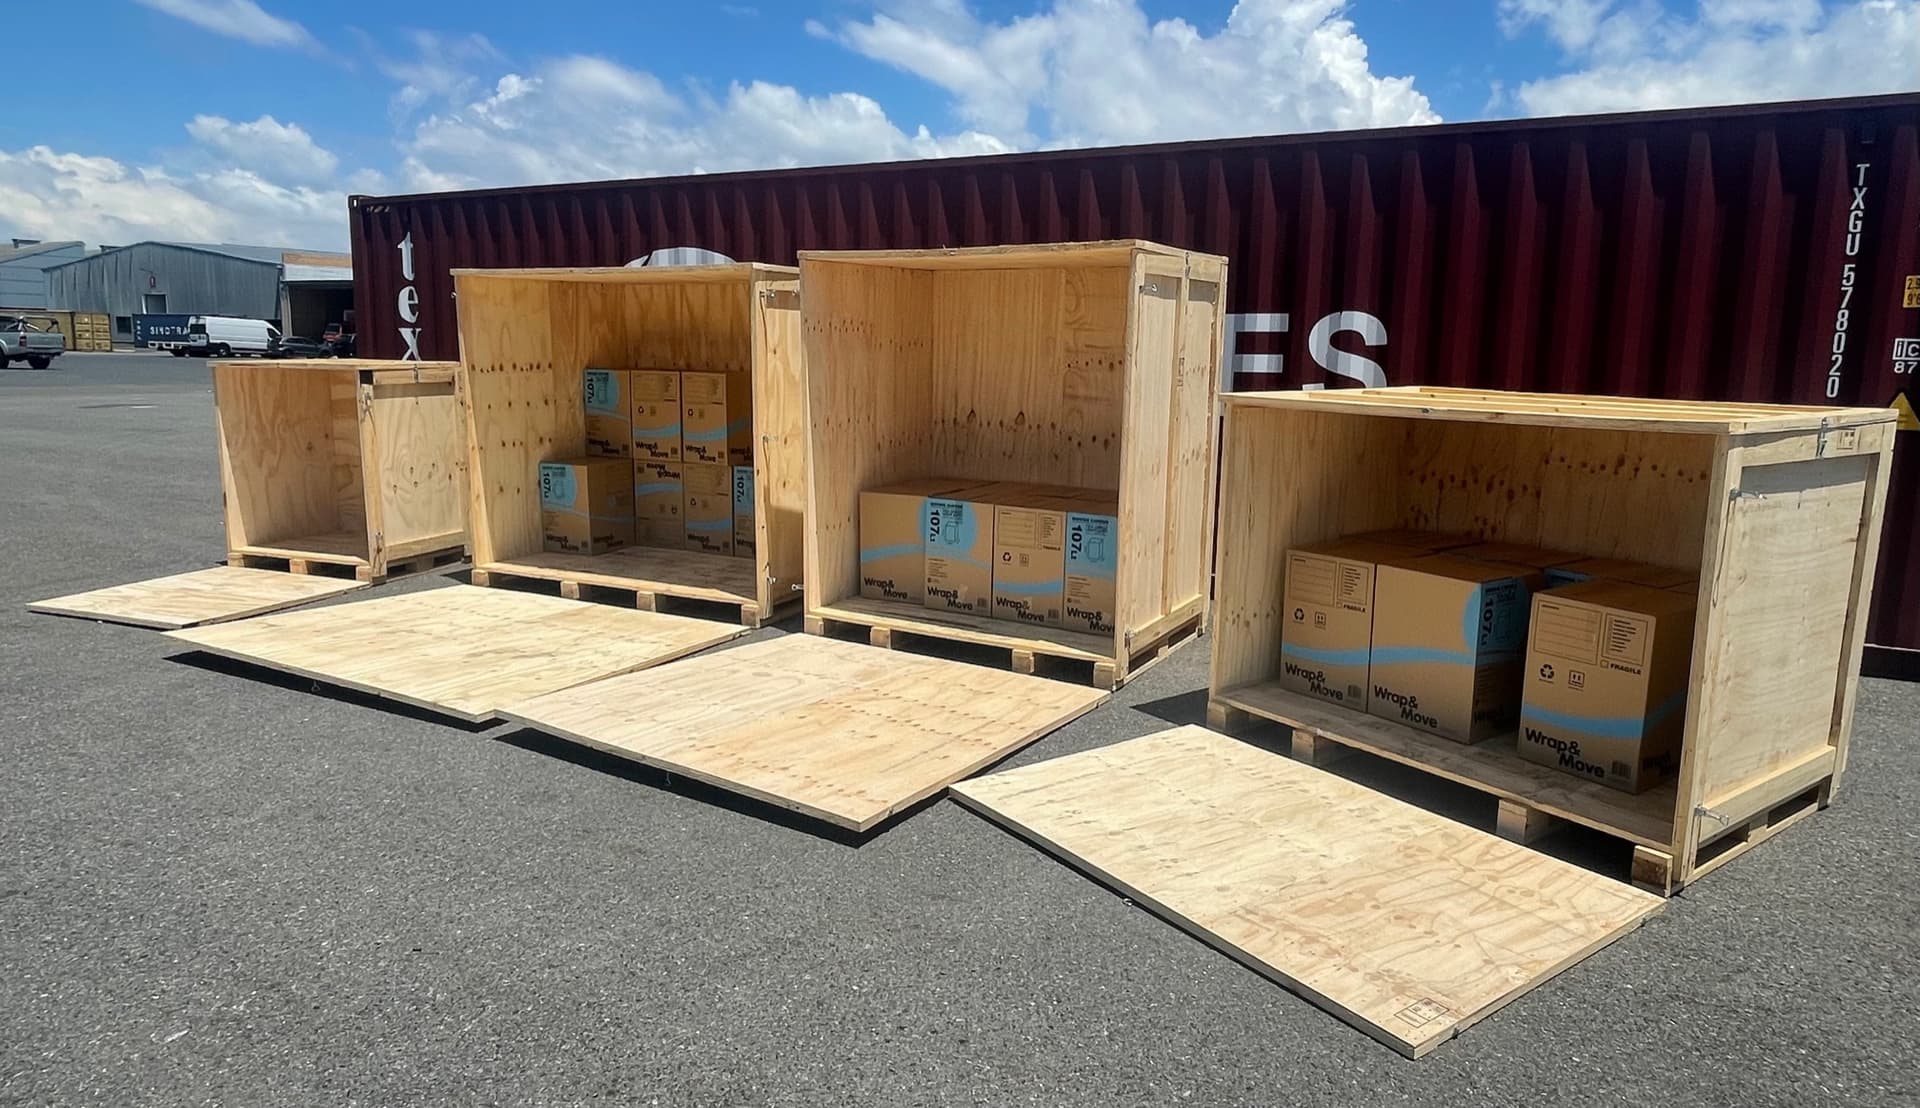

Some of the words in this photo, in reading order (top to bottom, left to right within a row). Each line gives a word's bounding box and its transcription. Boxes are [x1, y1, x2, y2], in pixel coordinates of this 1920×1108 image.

[1845, 163, 1871, 256] TXGU
[1826, 264, 1856, 398] 578020
[1894, 361, 1918, 374] 87
[1284, 662, 1326, 685] Wrap&
[1610, 662, 1642, 676] FRAGILE
[1310, 681, 1344, 701] Move
[1374, 684, 1418, 709] Wrap&
[1400, 706, 1439, 728] Move
[1525, 727, 1581, 756] Wrap&
[1558, 752, 1605, 779] Move
